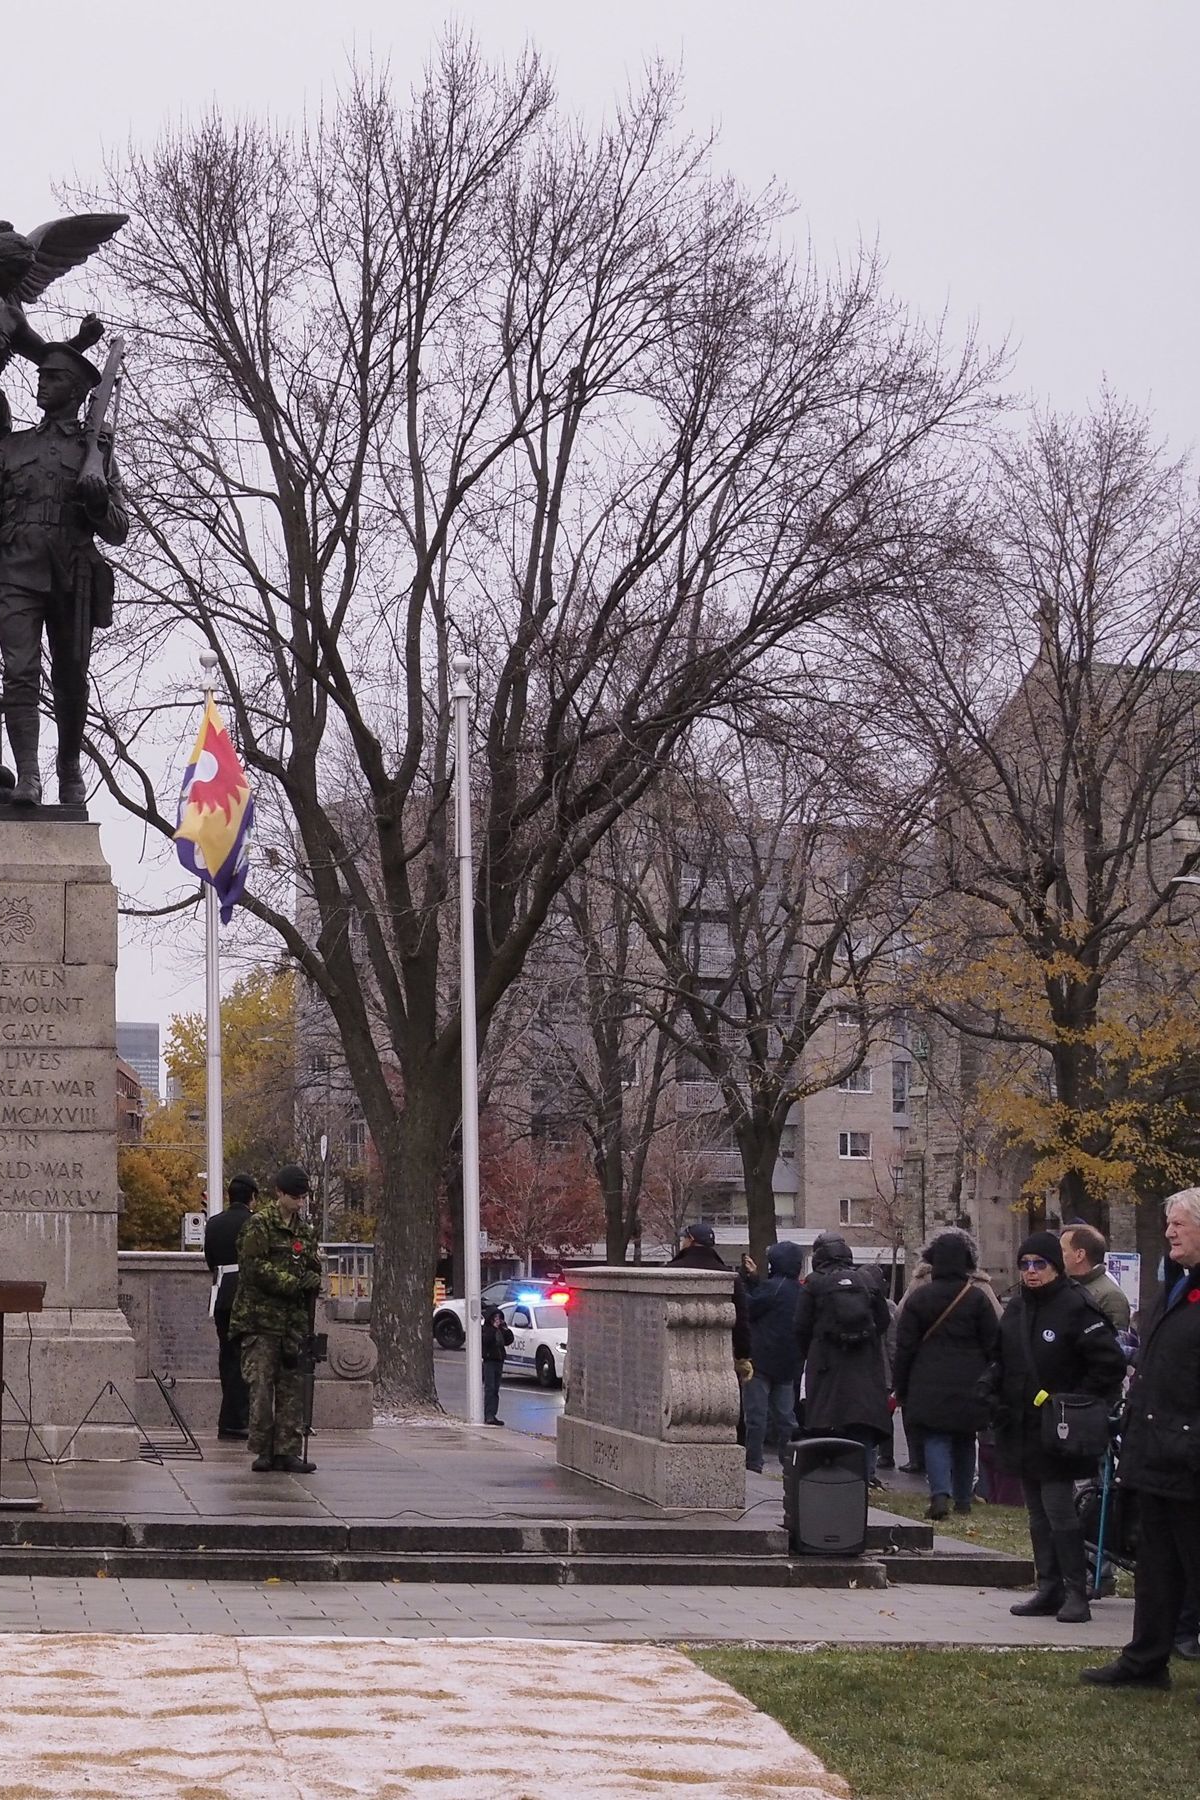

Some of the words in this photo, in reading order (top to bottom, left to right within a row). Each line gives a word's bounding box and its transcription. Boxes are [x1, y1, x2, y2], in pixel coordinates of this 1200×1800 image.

[21, 969, 67, 988] MEN
[2, 1023, 57, 1041] GAVE
[5, 1052, 62, 1070] LIVES
[51, 1080, 97, 1098] WAR
[17, 1134, 39, 1152] IN
[39, 1161, 84, 1180] WAR
[507, 1340, 526, 1351] OLICE
